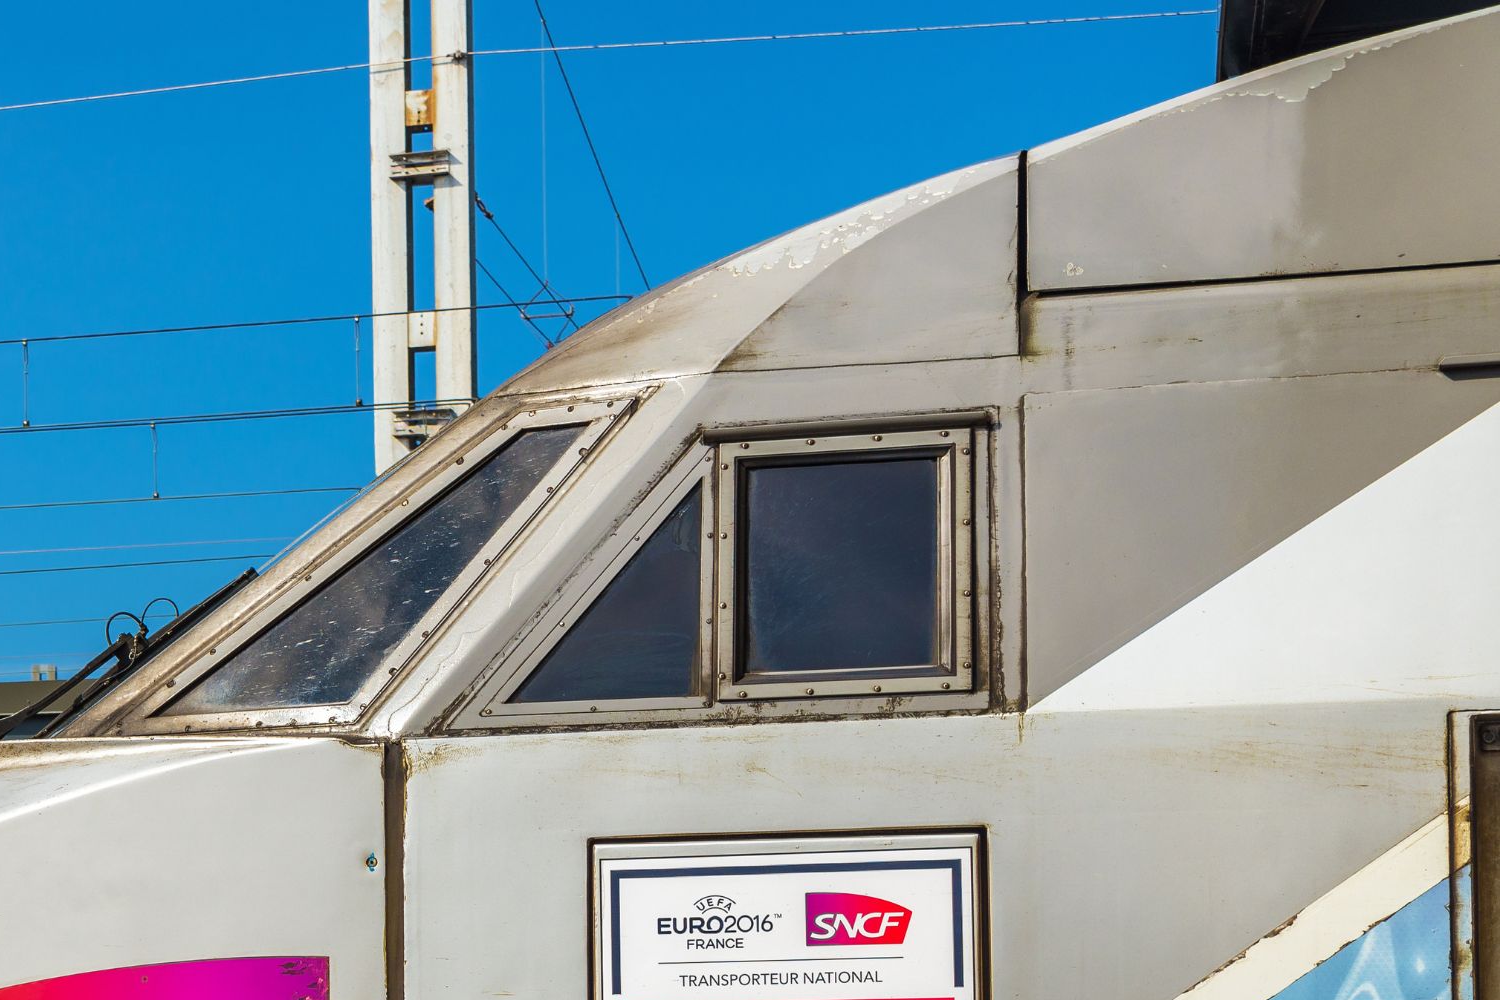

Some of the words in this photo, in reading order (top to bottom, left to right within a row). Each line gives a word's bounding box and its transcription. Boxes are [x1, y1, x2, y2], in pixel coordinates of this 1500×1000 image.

[696, 898, 732, 912] UEFA
[810, 912, 905, 940] SNCF
[687, 938, 744, 950] FRANCE
[679, 973, 799, 987] TRANSPORTEUR
[803, 971, 883, 985] NATIONAL
